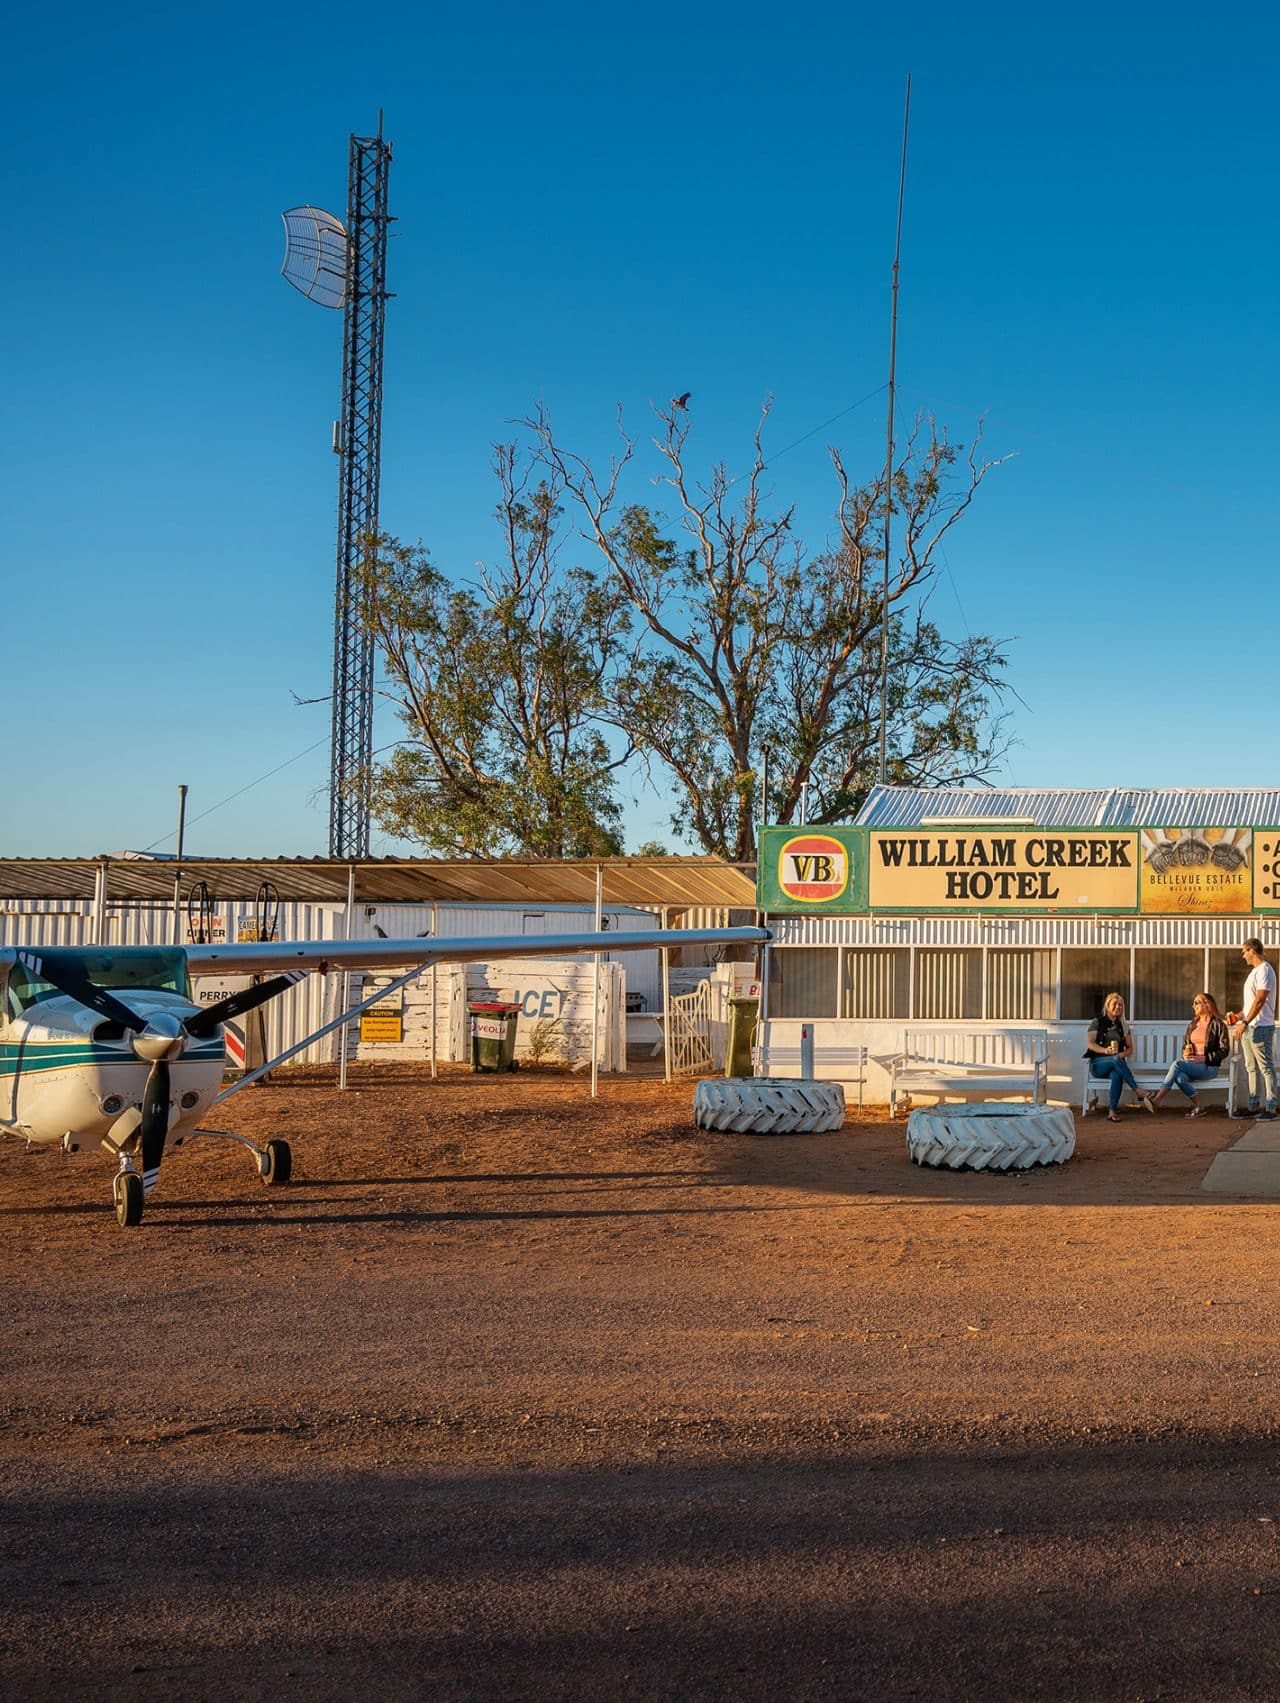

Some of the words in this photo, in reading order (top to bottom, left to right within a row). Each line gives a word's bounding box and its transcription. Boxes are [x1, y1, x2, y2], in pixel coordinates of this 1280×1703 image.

[878, 839, 1016, 867] WILLIAM
[1025, 839, 1131, 867] CREEK
[791, 855, 835, 882] VB
[1151, 875, 1201, 884] BELLEVUE
[1207, 875, 1243, 884] ESTATE
[945, 871, 1059, 899] HOTEL
[187, 929, 226, 937] DINER
